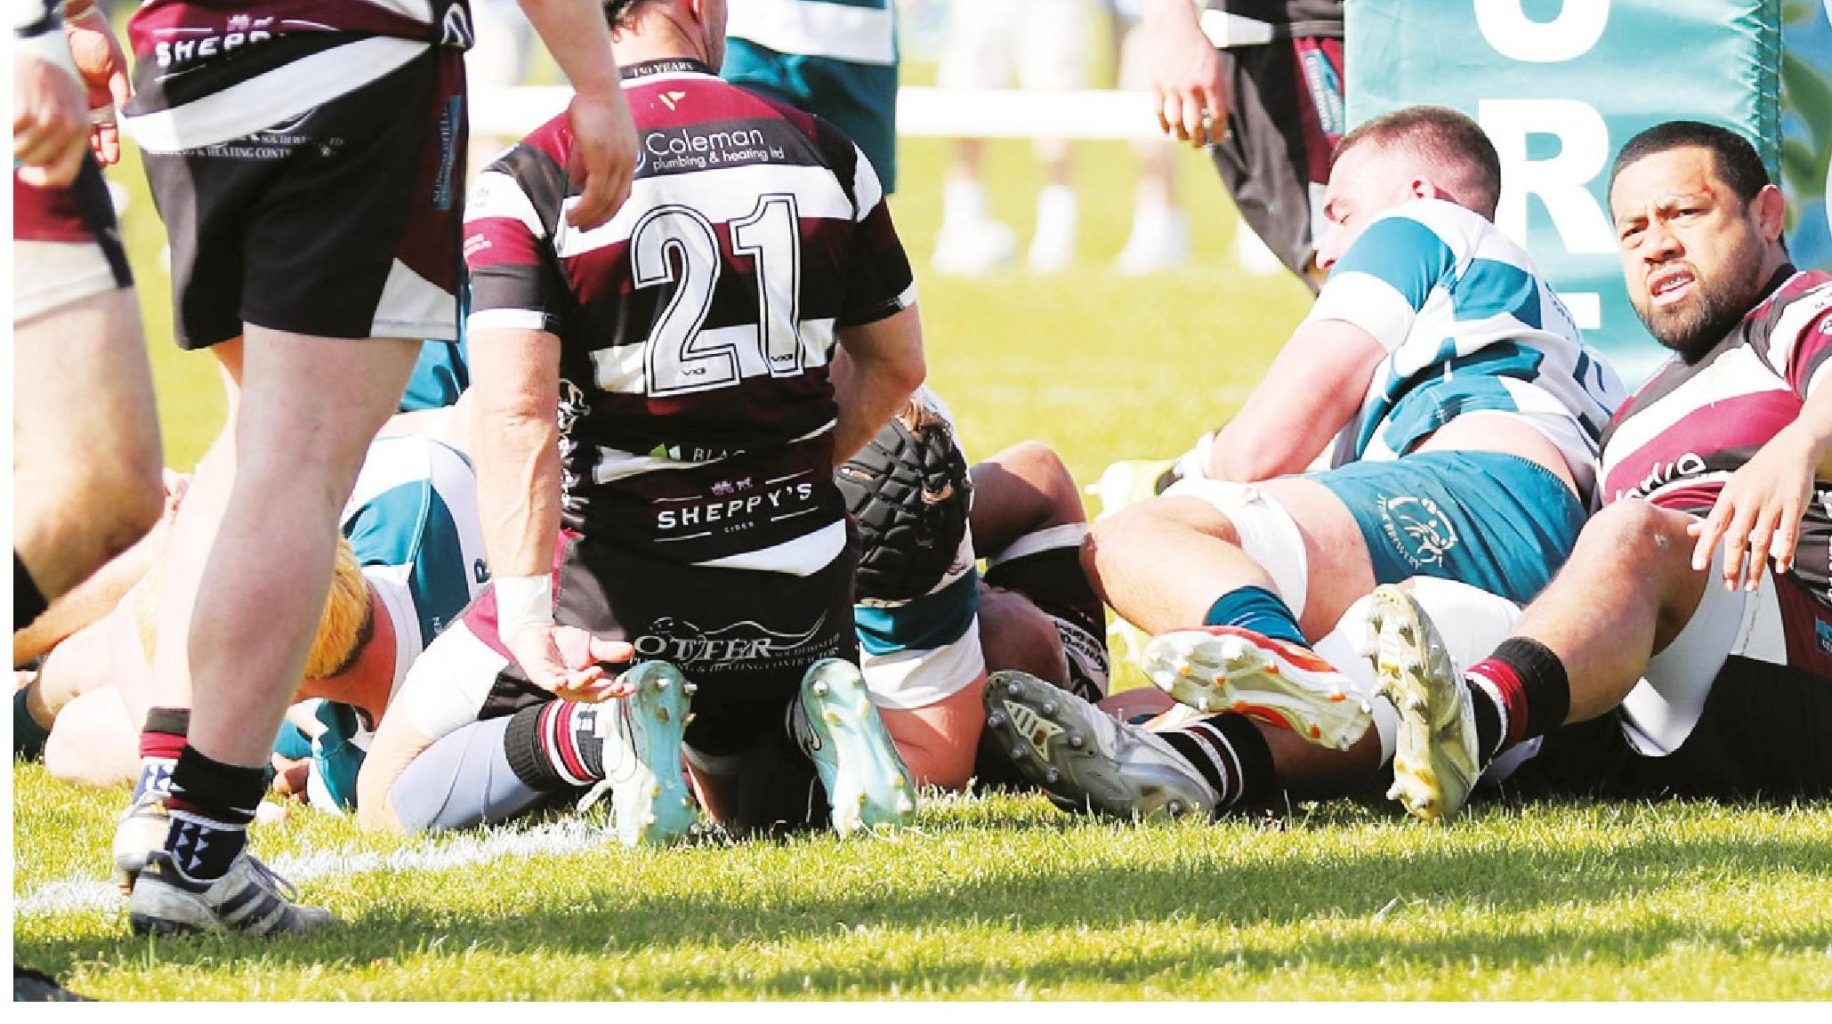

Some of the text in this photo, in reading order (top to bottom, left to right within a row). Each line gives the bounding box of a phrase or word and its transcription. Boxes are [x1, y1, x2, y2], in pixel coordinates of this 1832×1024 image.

[653, 61, 694, 75] YEARS
[646, 128, 765, 156] Coleman
[653, 145, 785, 171] plumbing & heating ltd
[629, 192, 805, 398] 21
[657, 482, 813, 530] SHEPPY'S
